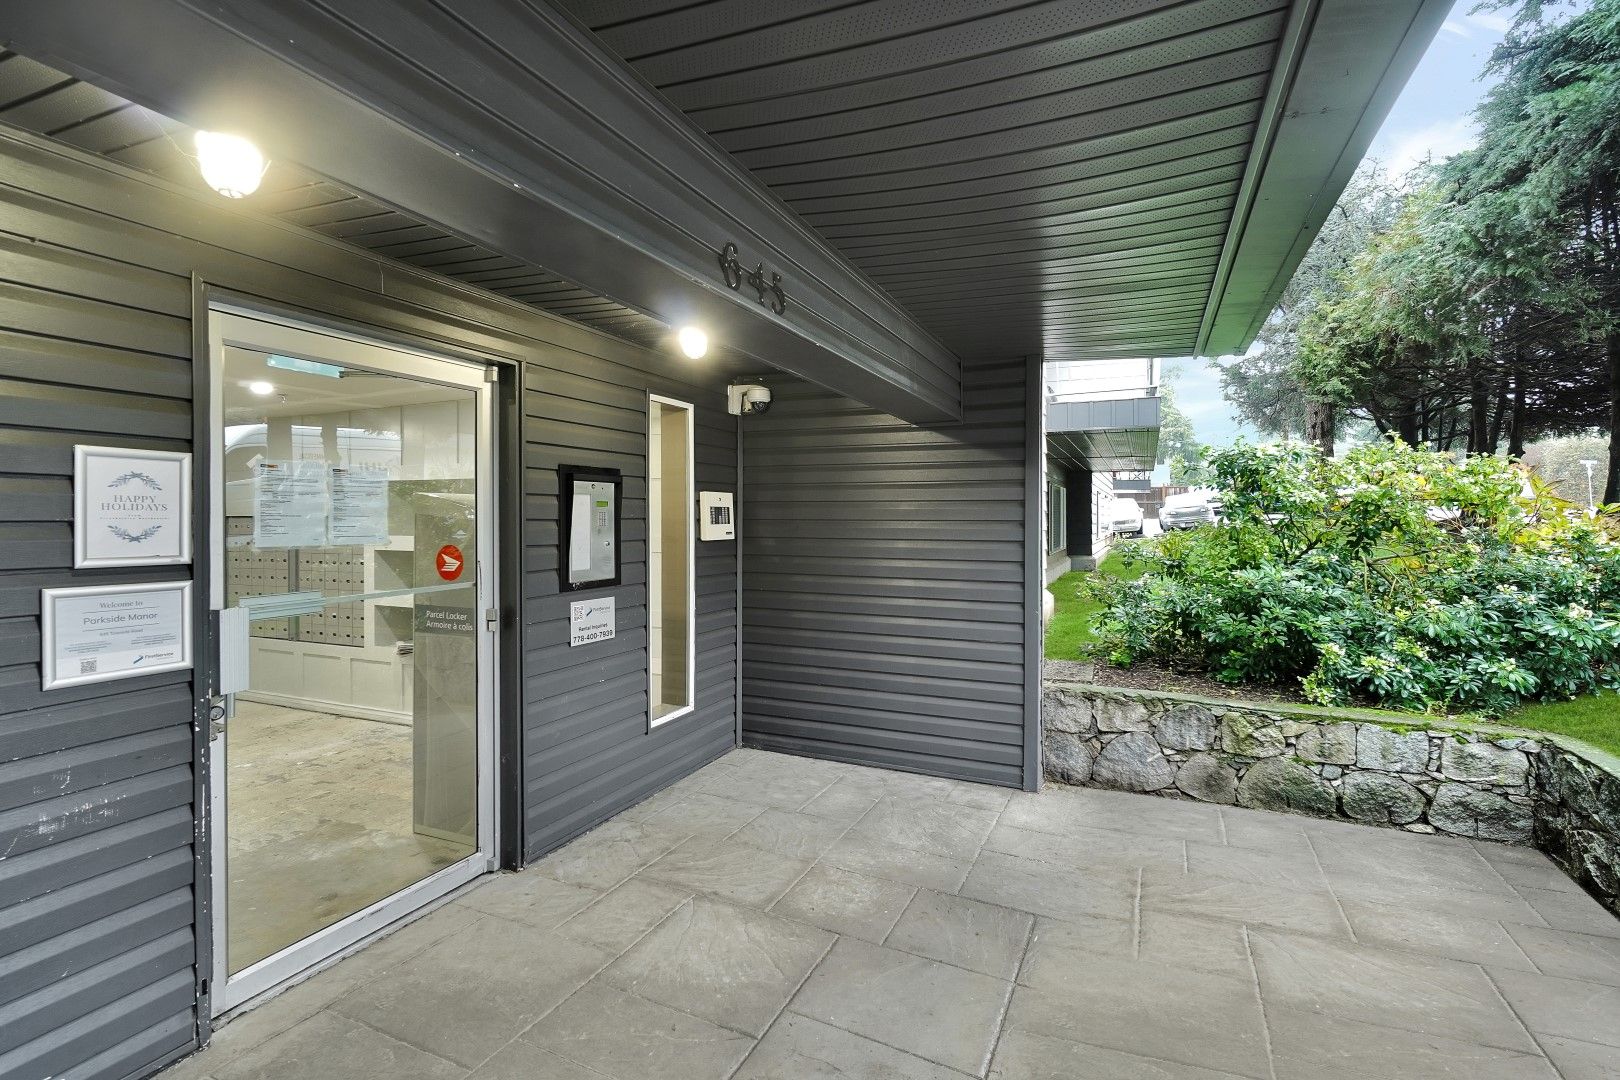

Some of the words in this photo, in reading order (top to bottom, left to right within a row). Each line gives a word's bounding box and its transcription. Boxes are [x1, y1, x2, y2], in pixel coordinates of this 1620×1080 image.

[720, 242, 786, 316] 645
[114, 495, 157, 504] HAPPY
[101, 503, 168, 512] HOLIDAYS
[99, 600, 135, 609] Welcome
[83, 615, 126, 625] Parkside
[128, 612, 158, 621] Manor
[426, 610, 445, 619] Parcel
[446, 612, 468, 620] Locker
[426, 620, 451, 629] Armoire
[452, 621, 457, 630] à
[458, 622, 473, 631] colis
